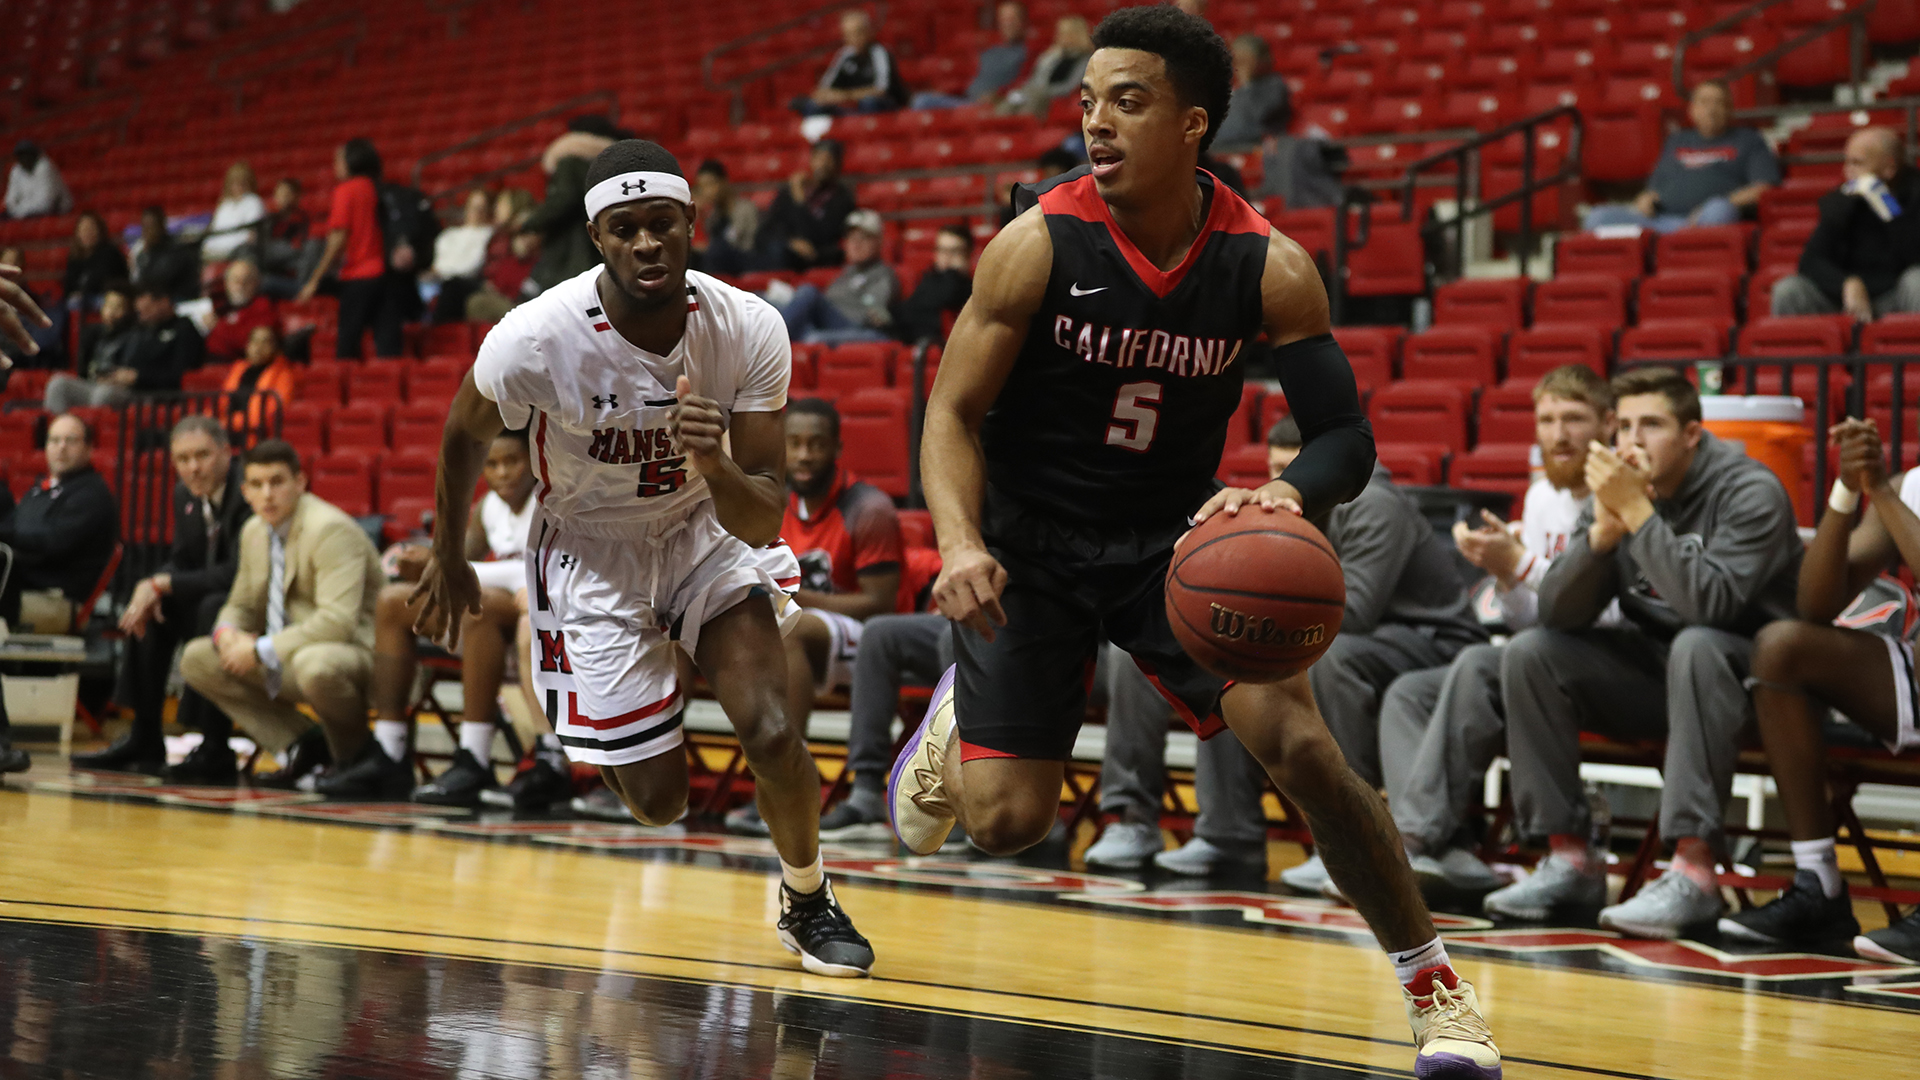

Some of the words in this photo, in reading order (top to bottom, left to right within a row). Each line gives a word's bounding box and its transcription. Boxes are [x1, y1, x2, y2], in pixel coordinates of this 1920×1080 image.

[1104, 379, 1163, 454] 5
[588, 427, 678, 464] MANS
[636, 456, 688, 498] 5
[1209, 601, 1325, 646] Wilson
[536, 628, 574, 675] M
